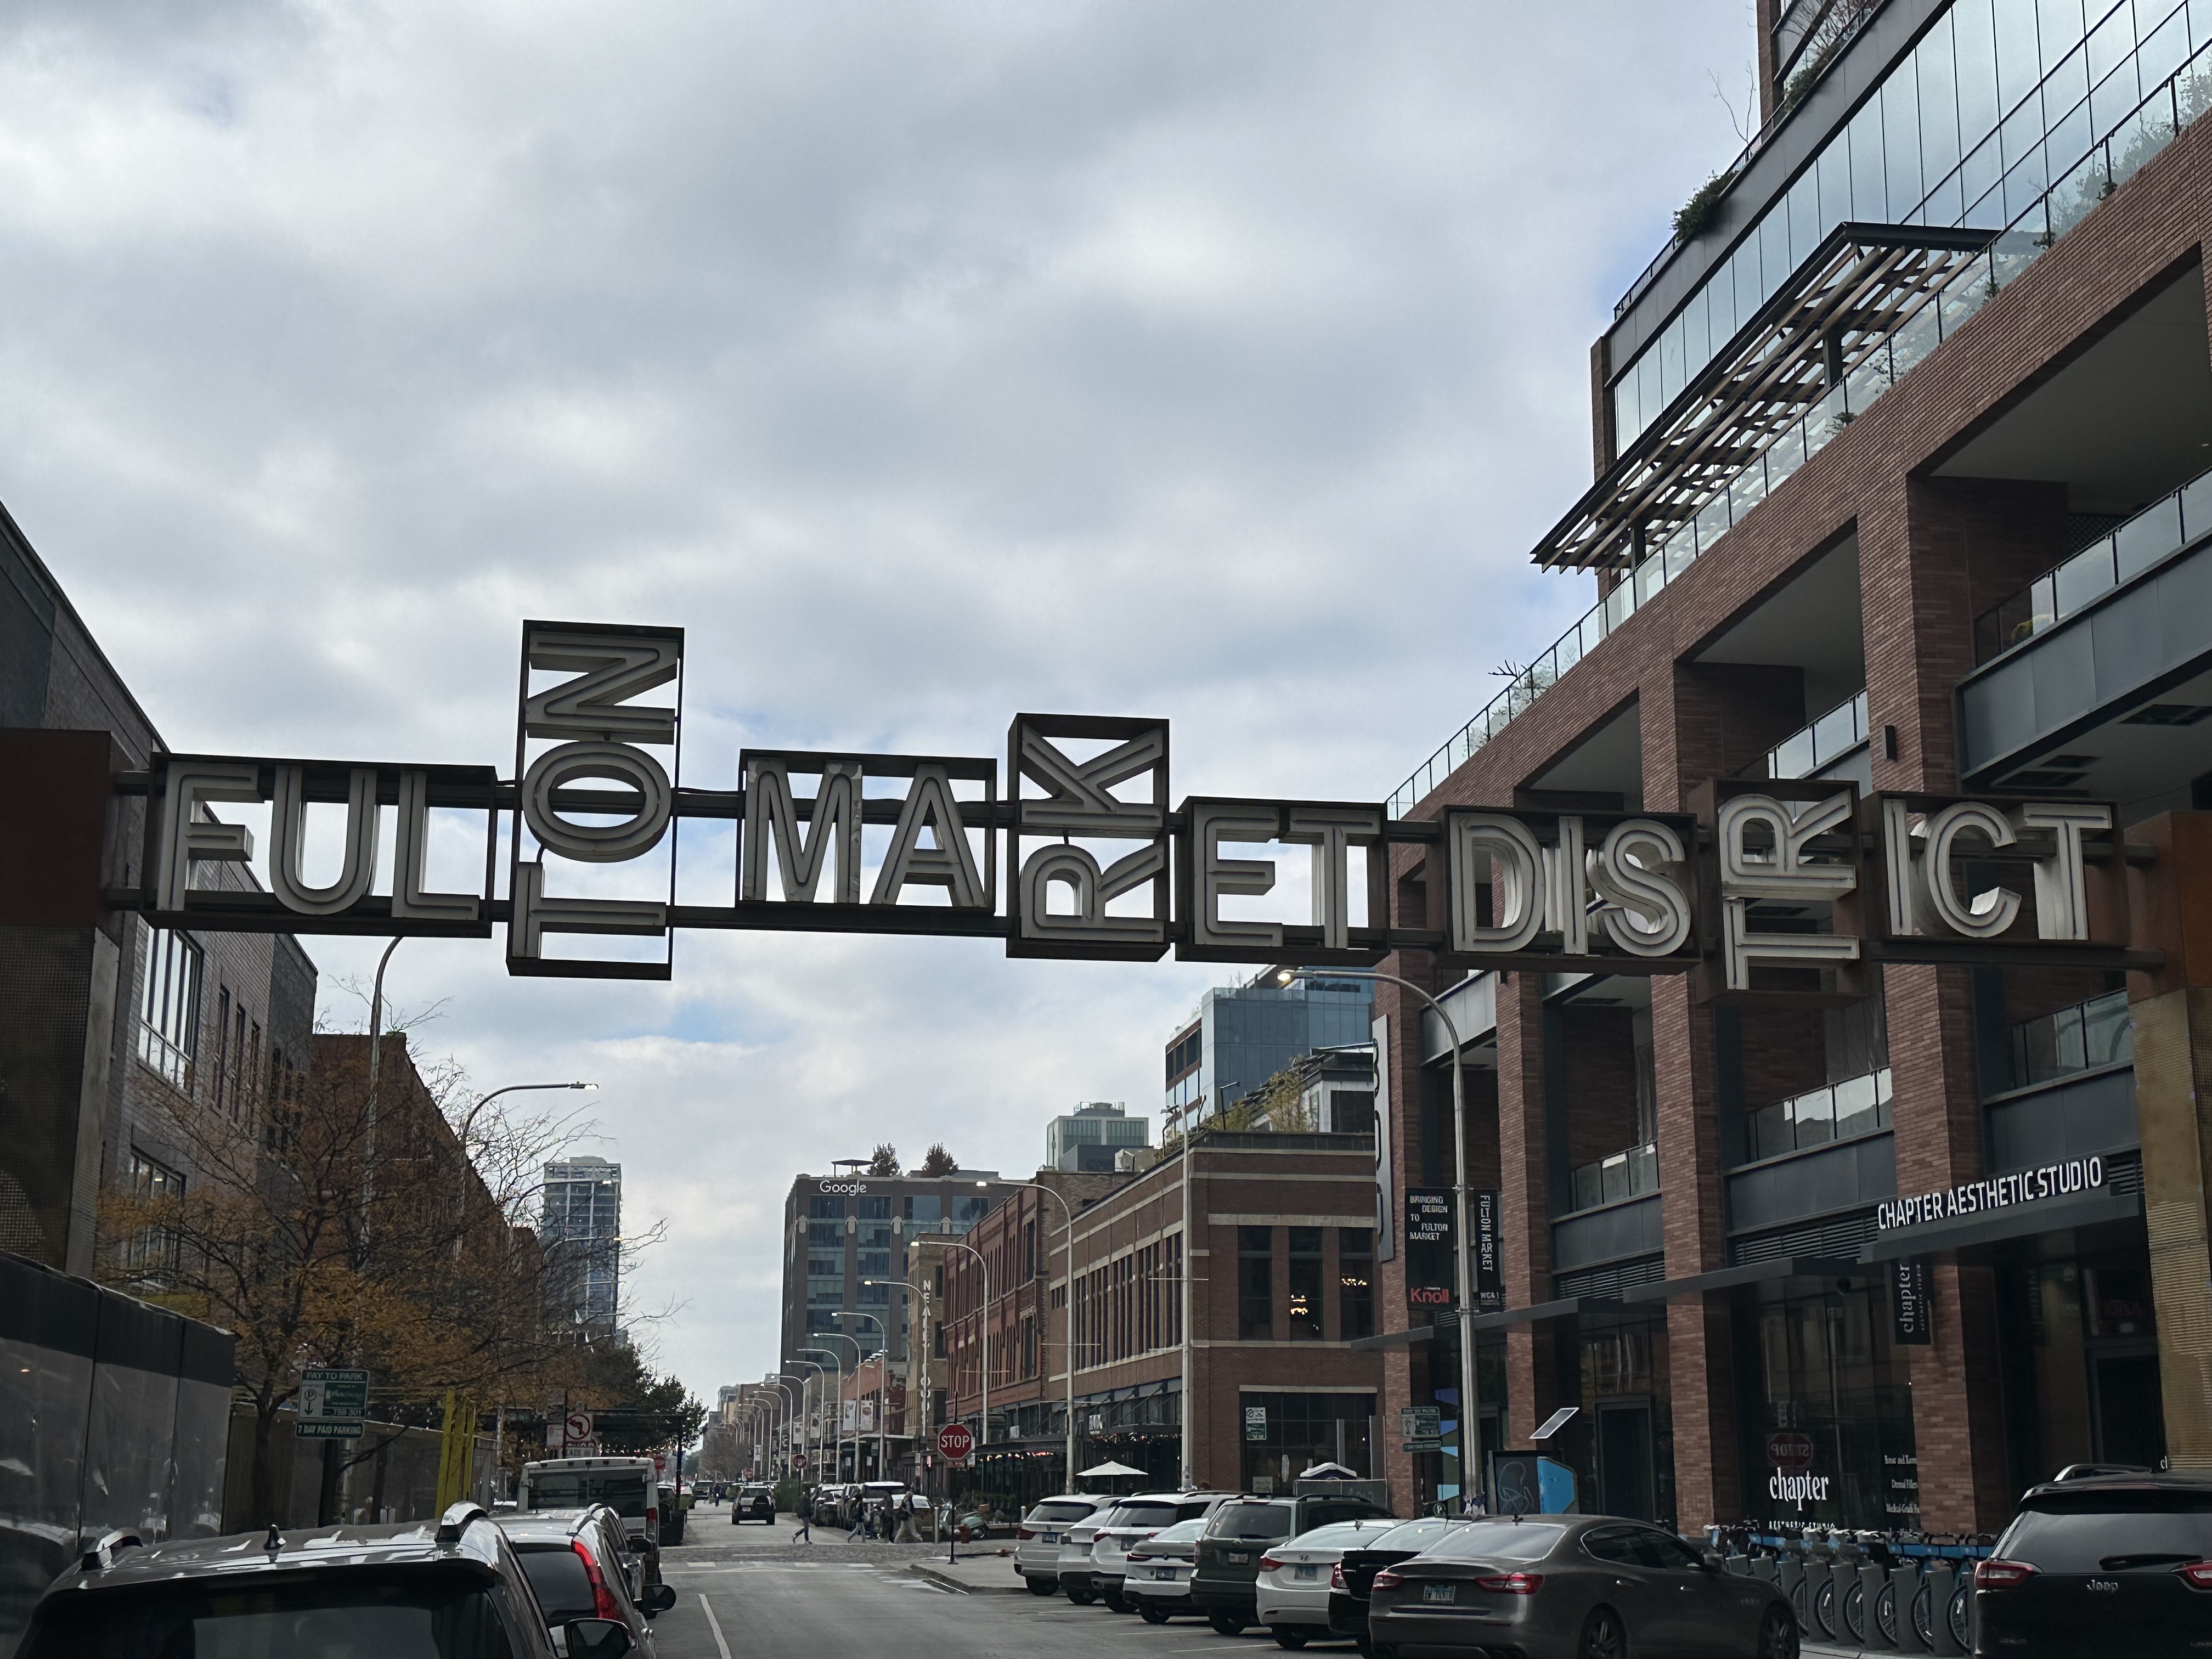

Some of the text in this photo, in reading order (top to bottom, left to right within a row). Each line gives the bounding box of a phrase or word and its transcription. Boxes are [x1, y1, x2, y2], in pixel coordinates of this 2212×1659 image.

[156, 630, 2113, 991] FULTON MARKET DISTRICT
[820, 1179, 867, 1197] Google
[1877, 1156, 2102, 1230] CHAPTER AESTHETIC STUDIO
[1410, 1214, 1420, 1222] TO
[1421, 1223, 1448, 1231] FULTON
[1480, 1195, 1493, 1272] FULTON MARKET
[1410, 1288, 1449, 1304] Knoll
[1899, 1263, 1917, 1333] chapter
[306, 1372, 323, 1380] PAY
[339, 1372, 363, 1380] PARK
[941, 1435, 970, 1448] STOP
[1769, 1466, 1830, 1511] chapter
[2086, 1579, 2119, 1594] Jeep
